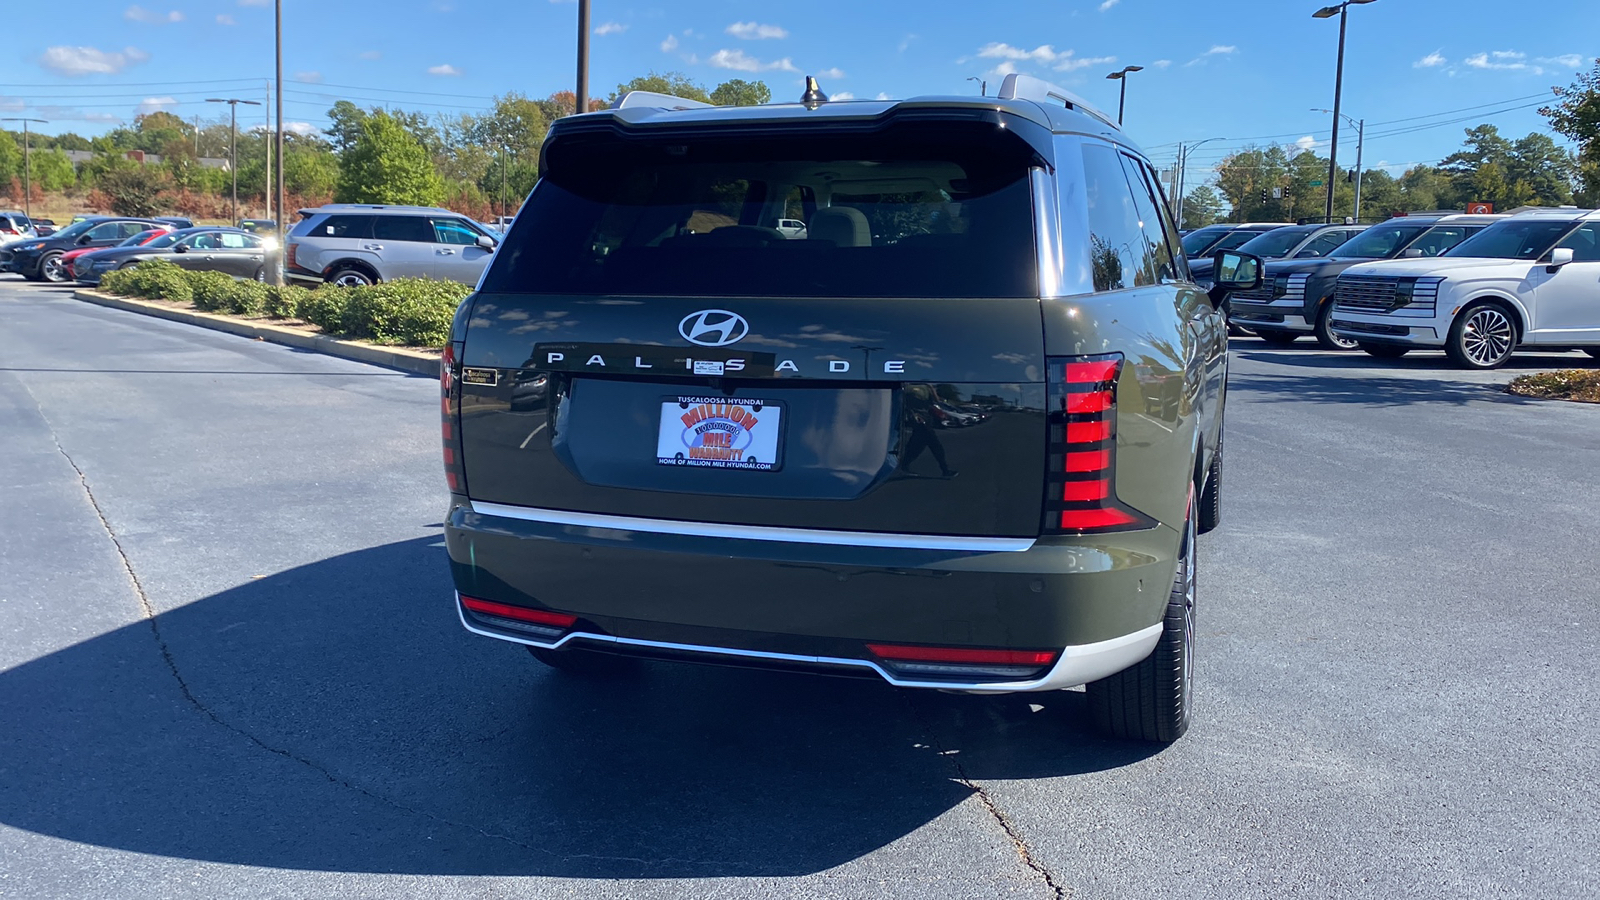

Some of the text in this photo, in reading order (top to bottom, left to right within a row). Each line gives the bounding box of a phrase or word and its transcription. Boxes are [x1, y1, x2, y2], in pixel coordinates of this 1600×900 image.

[547, 352, 905, 373] PALISADE
[727, 398, 764, 406] HYUNDAI
[681, 404, 758, 431] MILLION
[703, 433, 732, 448] MILE
[689, 447, 744, 460] WARRANTY
[726, 462, 771, 470] HYUNDAI.COM
